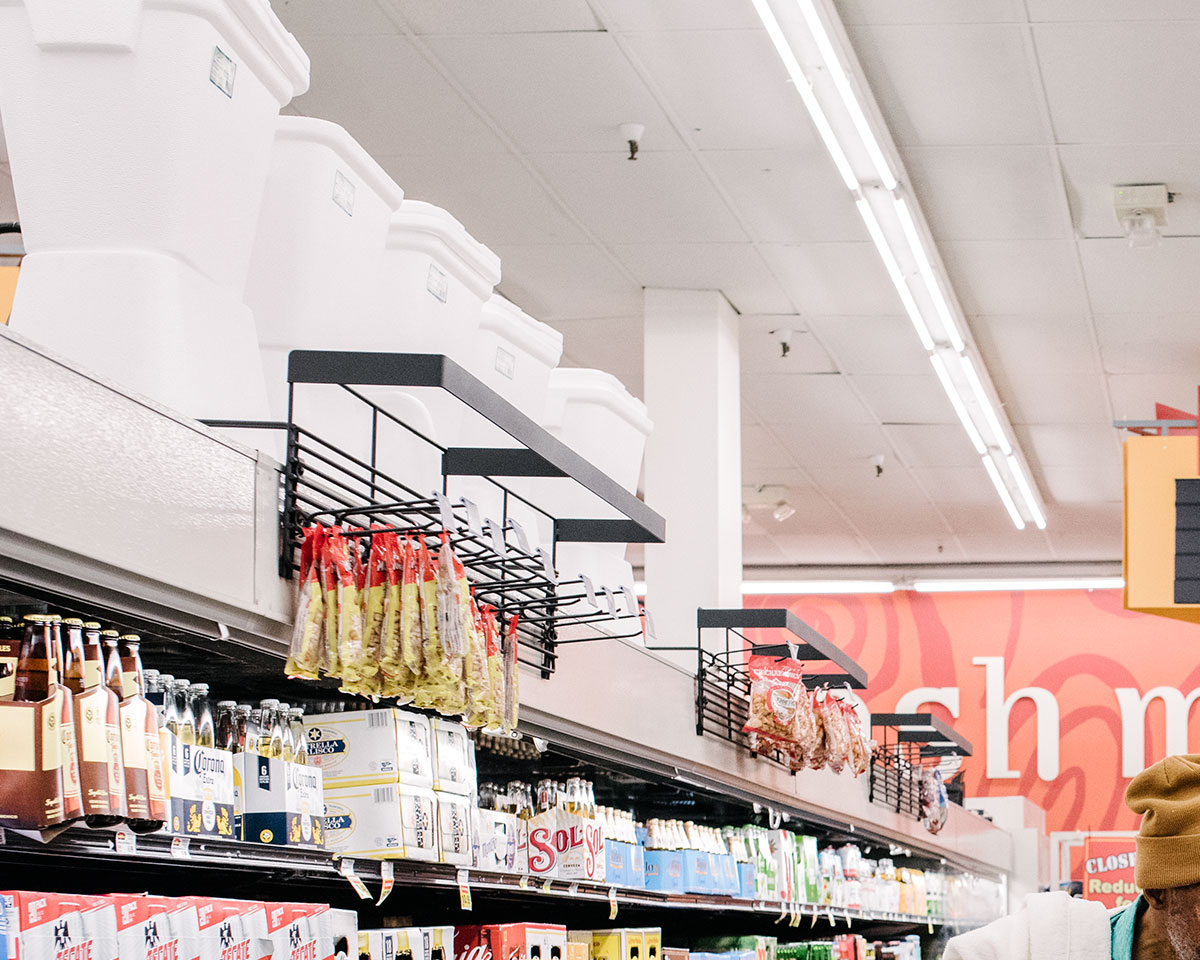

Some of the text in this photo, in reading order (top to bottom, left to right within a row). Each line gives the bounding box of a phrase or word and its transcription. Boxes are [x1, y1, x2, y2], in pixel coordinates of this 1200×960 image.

[194, 749, 226, 775] Corona
[260, 765, 268, 776] 6
[529, 826, 584, 873] SOL
